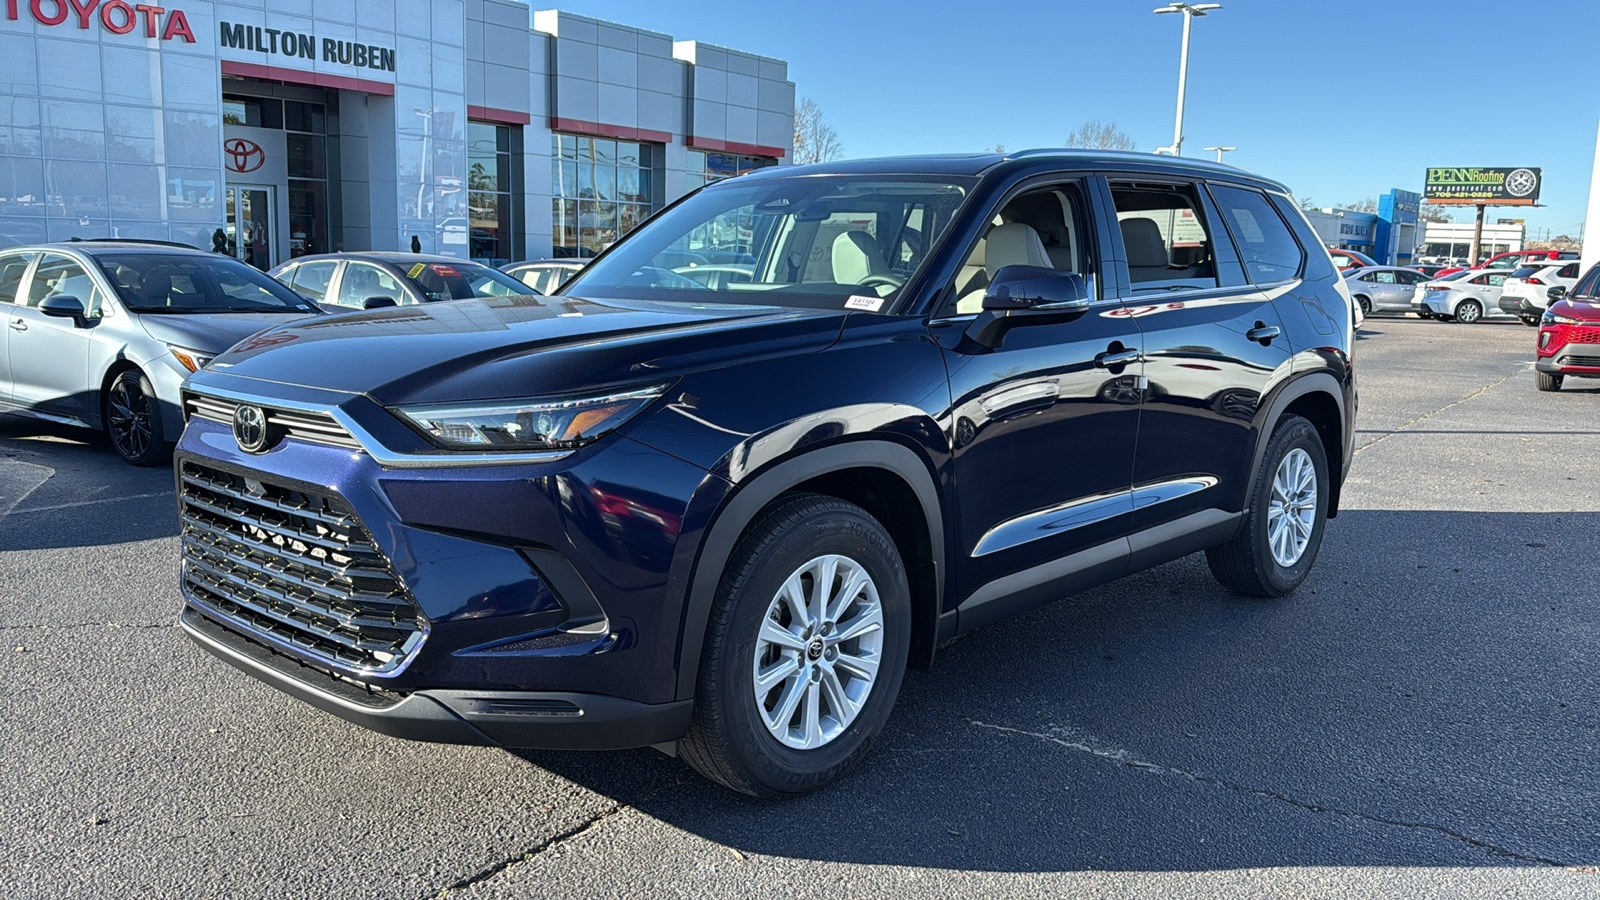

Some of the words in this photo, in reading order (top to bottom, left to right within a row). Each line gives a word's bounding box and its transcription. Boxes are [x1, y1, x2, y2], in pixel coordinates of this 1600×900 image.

[220, 21, 315, 60] MILTON
[323, 38, 395, 72] RUBEN
[1428, 168, 1477, 182] PENN
[1473, 170, 1504, 184] Roofing
